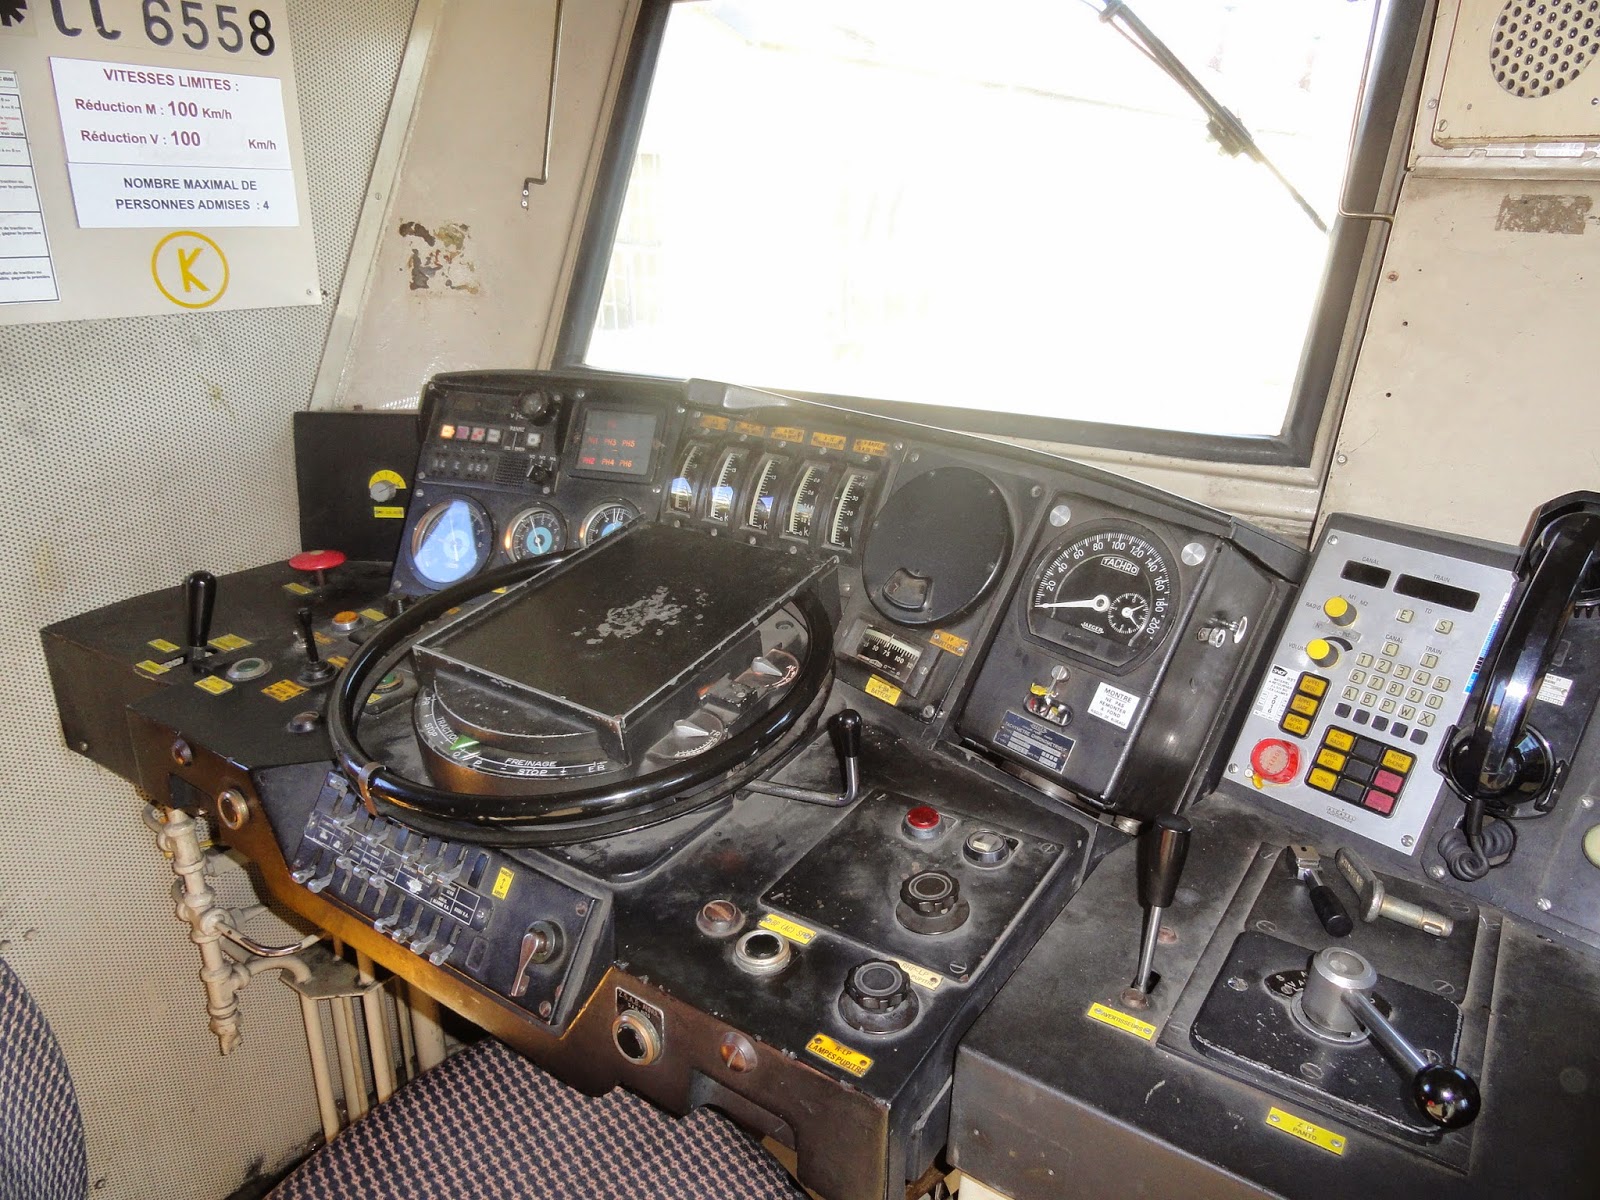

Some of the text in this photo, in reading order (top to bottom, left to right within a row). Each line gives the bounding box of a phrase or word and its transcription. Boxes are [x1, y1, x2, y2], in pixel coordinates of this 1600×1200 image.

[142, 0, 276, 56] 6558
[103, 68, 175, 87] VITESSES
[179, 75, 231, 92] LIMITES
[75, 98, 142, 115] Réduction
[146, 103, 157, 115] M
[168, 101, 198, 118] 100
[202, 107, 233, 120] Km/h
[81, 130, 147, 146] Réduction
[150, 134, 159, 145] V
[170, 131, 201, 147] 100
[248, 139, 277, 151] Km/h
[124, 178, 257, 191] NOMBRE MAXIMAL DE
[115, 199, 195, 210] PERSONNES
[198, 199, 250, 210] ADMISES
[263, 201, 269, 210] 4
[177, 248, 210, 293] K
[1092, 541, 1104, 551] 80
[1112, 541, 1126, 551] 100
[1130, 545, 1145, 559] 120
[1073, 549, 1085, 560] 60
[1361, 556, 1380, 565] CANAL
[1058, 562, 1068, 574] 40
[1103, 557, 1138, 575] TACHRO
[1144, 558, 1158, 573] 140
[1154, 576, 1165, 592] 160
[1433, 574, 1450, 583] TRAIN
[1046, 580, 1057, 592] 20
[1155, 598, 1164, 613] 180
[1400, 610, 1408, 619] E
[1146, 617, 1161, 635] 200
[1439, 621, 1448, 630] S
[1385, 634, 1404, 644] CANAL
[1386, 644, 1393, 653] C
[1425, 645, 1443, 655] TRAIN
[1378, 661, 1386, 671] 2
[1397, 667, 1404, 676] 3
[1417, 673, 1424, 681] 4
[1436, 679, 1443, 688] 5
[1352, 672, 1359, 681] 6
[1372, 677, 1379, 687] 7
[1390, 684, 1397, 693] 8
[1410, 690, 1417, 699] 9
[1104, 687, 1133, 703] MONTRE
[1099, 700, 1127, 714] REMONTER
[1344, 688, 1430, 724] A B P W X
[424, 722, 438, 738] STOP
[505, 757, 557, 768] FREINAGE
[780, 922, 795, 934] (AC)
[1101, 1011, 1144, 1032] AVERTISSEURS
[808, 1042, 865, 1076] LAMPES PUPITRE
[1292, 1127, 1317, 1141] PANTO
